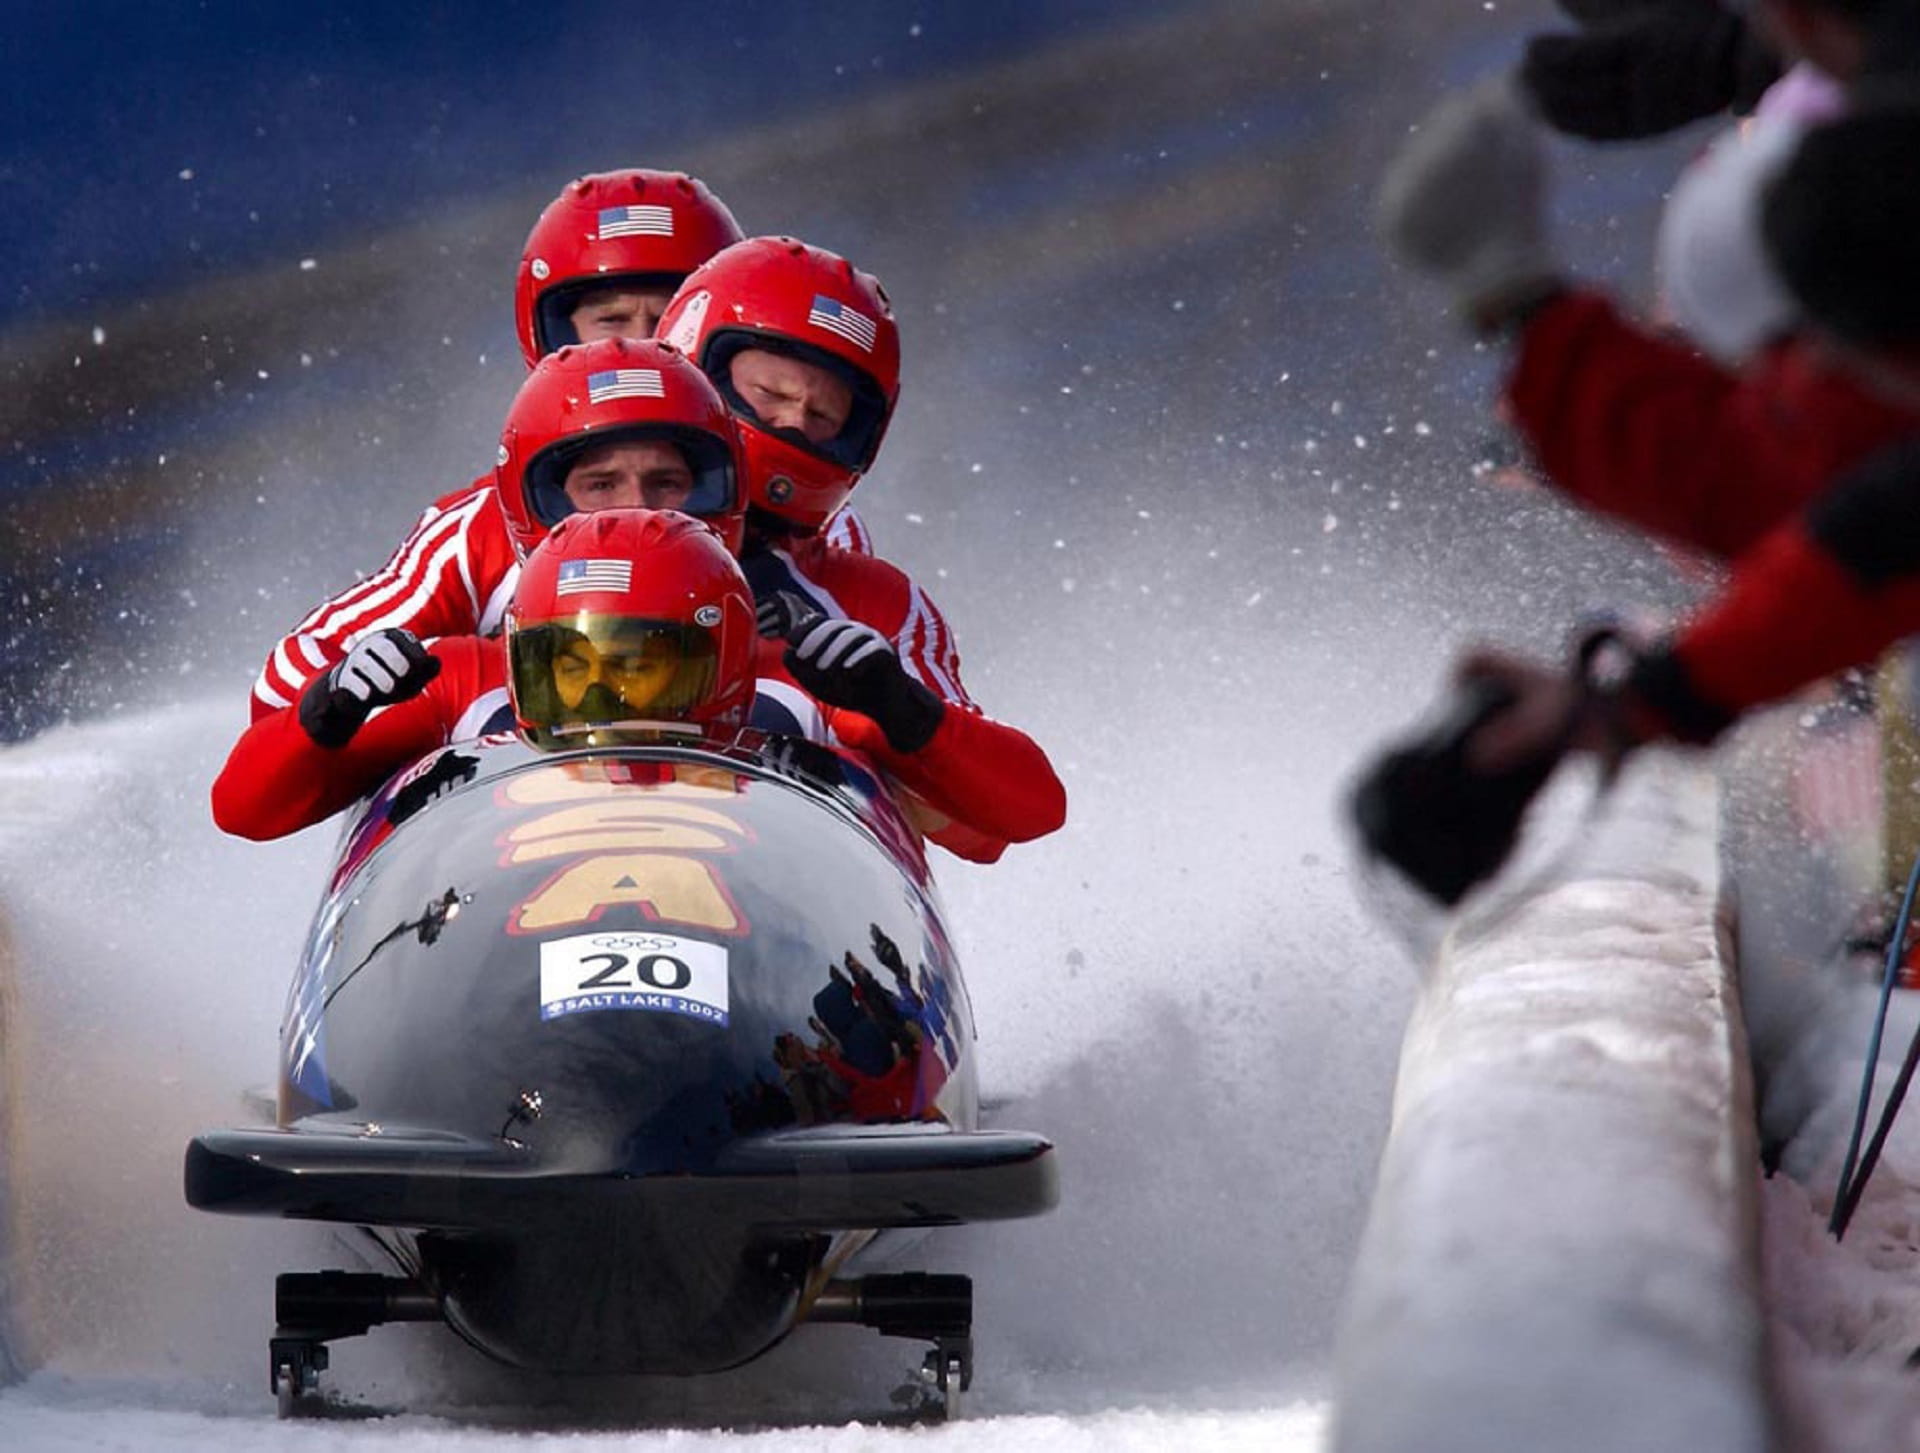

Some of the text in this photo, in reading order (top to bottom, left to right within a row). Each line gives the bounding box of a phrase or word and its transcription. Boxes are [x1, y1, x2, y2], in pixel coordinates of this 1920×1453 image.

[578, 953, 692, 990] 20
[565, 994, 723, 1021] SALT LAKE 2002
